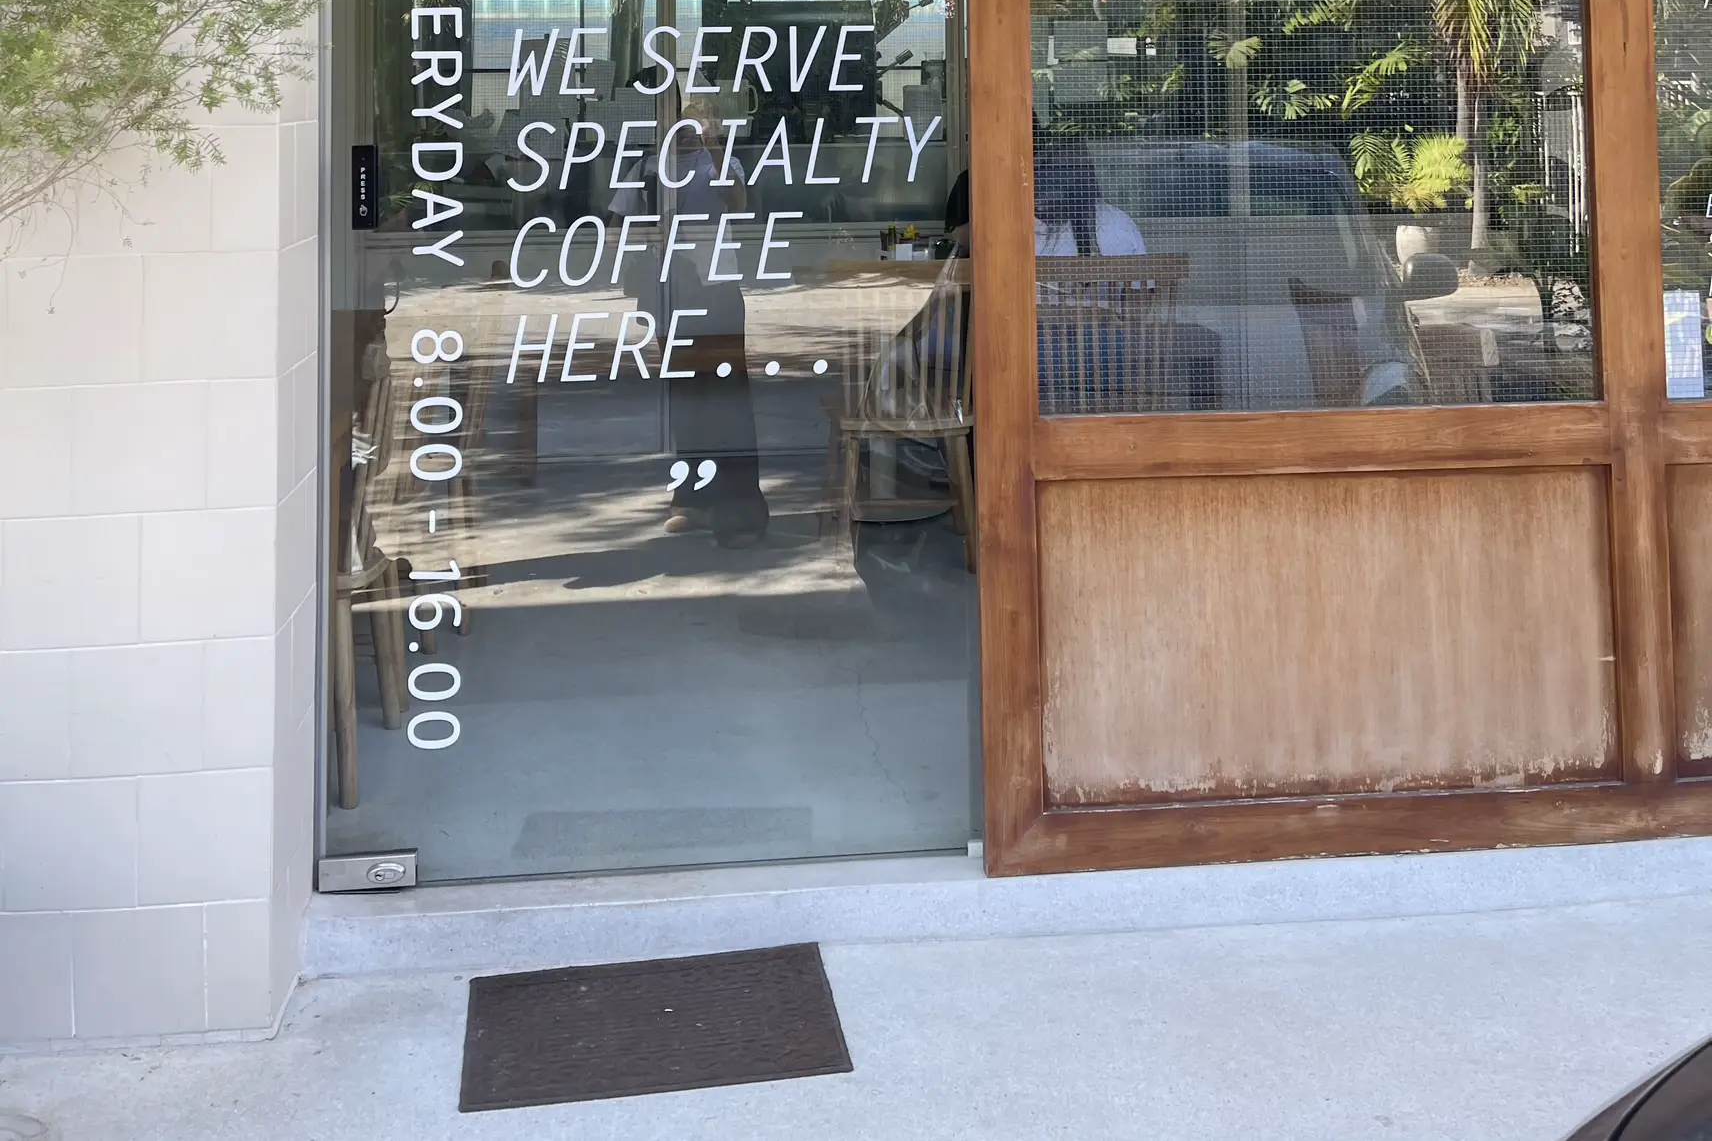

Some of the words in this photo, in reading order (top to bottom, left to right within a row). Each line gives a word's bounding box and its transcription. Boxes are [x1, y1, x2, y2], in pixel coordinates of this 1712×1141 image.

[506, 27, 608, 98] WE
[632, 24, 875, 95] SERVE
[506, 115, 942, 193] SPECIALTY
[509, 211, 804, 289] COFFEE
[410, 328, 464, 481] 8.00
[406, 559, 462, 750] 16.00
